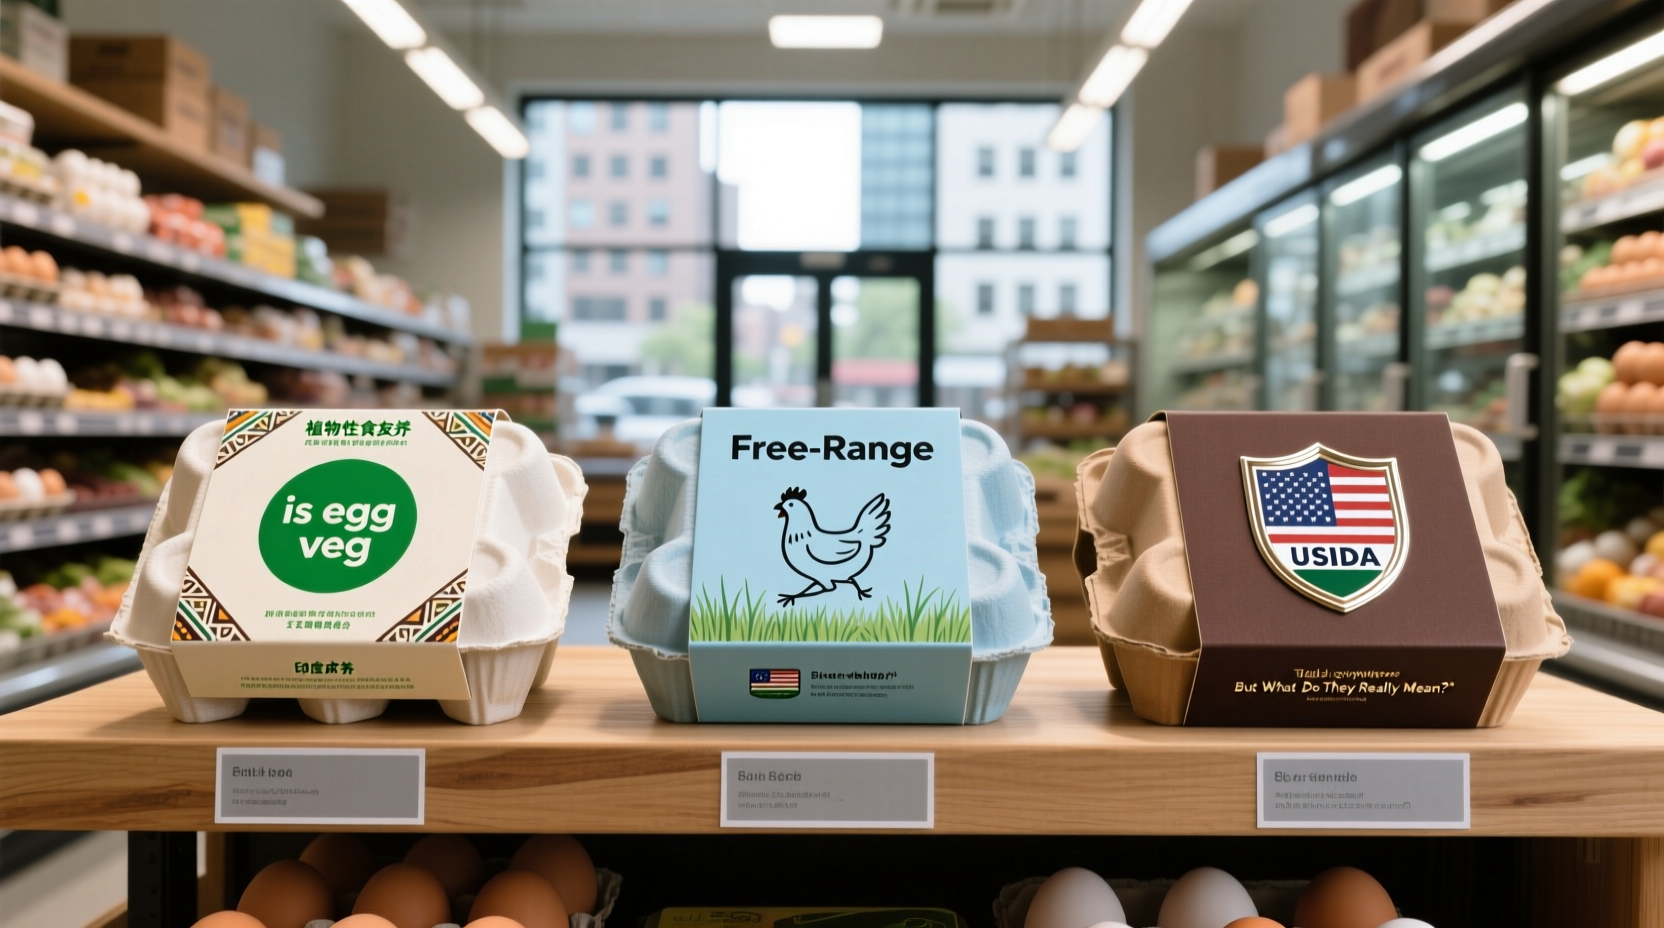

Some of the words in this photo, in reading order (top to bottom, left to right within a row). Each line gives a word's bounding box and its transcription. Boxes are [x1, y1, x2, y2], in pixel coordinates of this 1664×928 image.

[731, 434, 934, 468] Free-Range
[282, 495, 313, 525] is
[322, 502, 396, 533] egg
[299, 536, 372, 568] veg
[1290, 546, 1382, 567] USIDA
[1234, 681, 1258, 693] But
[1262, 681, 1296, 693] What
[1301, 681, 1320, 693] Do
[1323, 681, 1355, 696] They
[1358, 681, 1400, 696] Really
